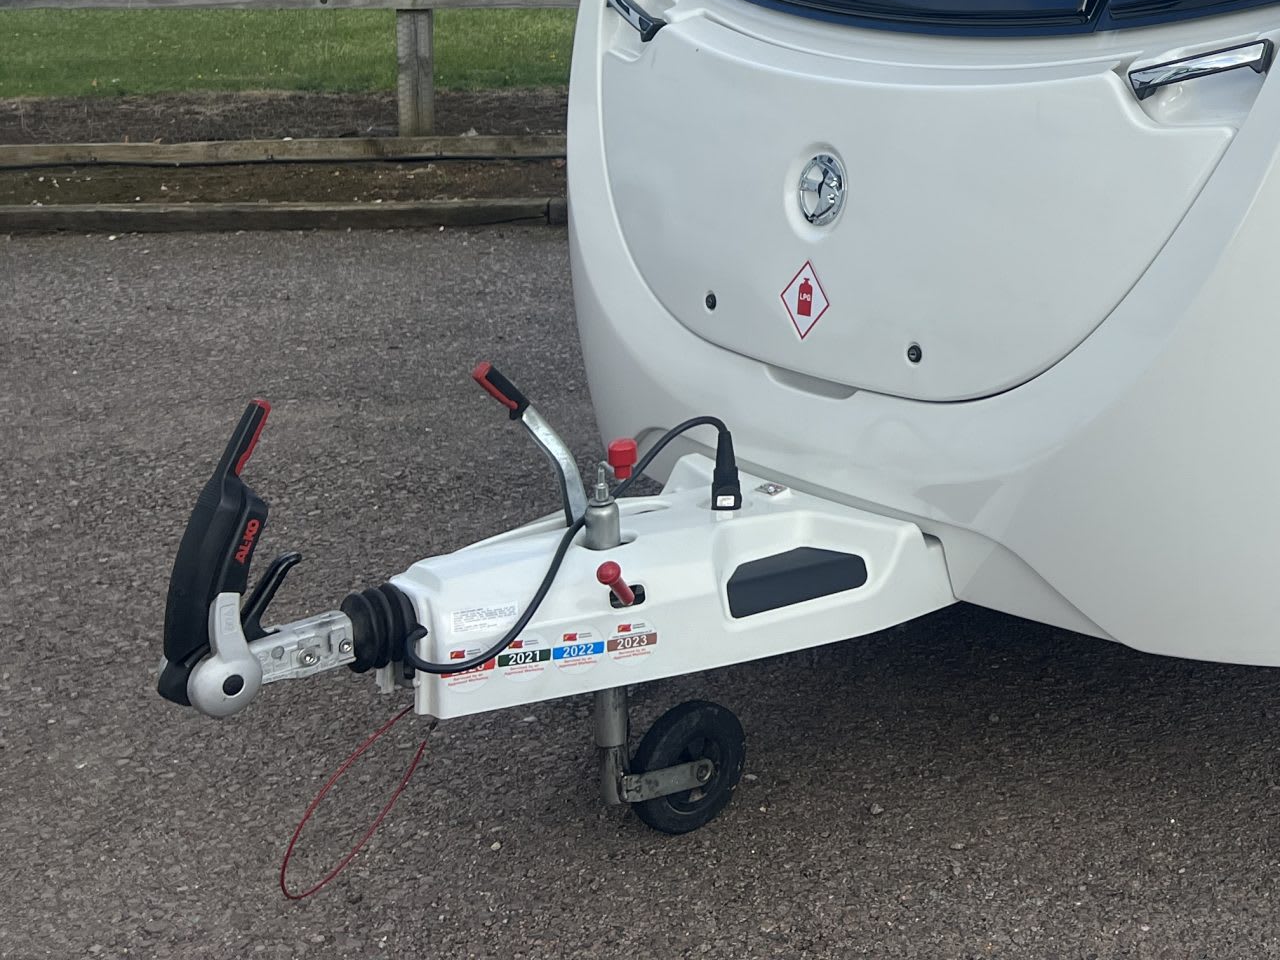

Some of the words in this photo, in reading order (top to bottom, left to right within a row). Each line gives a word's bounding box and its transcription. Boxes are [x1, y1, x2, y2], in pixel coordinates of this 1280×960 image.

[799, 292, 811, 302] LPG
[234, 519, 260, 565] AL-KO
[616, 634, 648, 650] 2023
[508, 650, 540, 665] 2021
[562, 643, 594, 658] 2022
